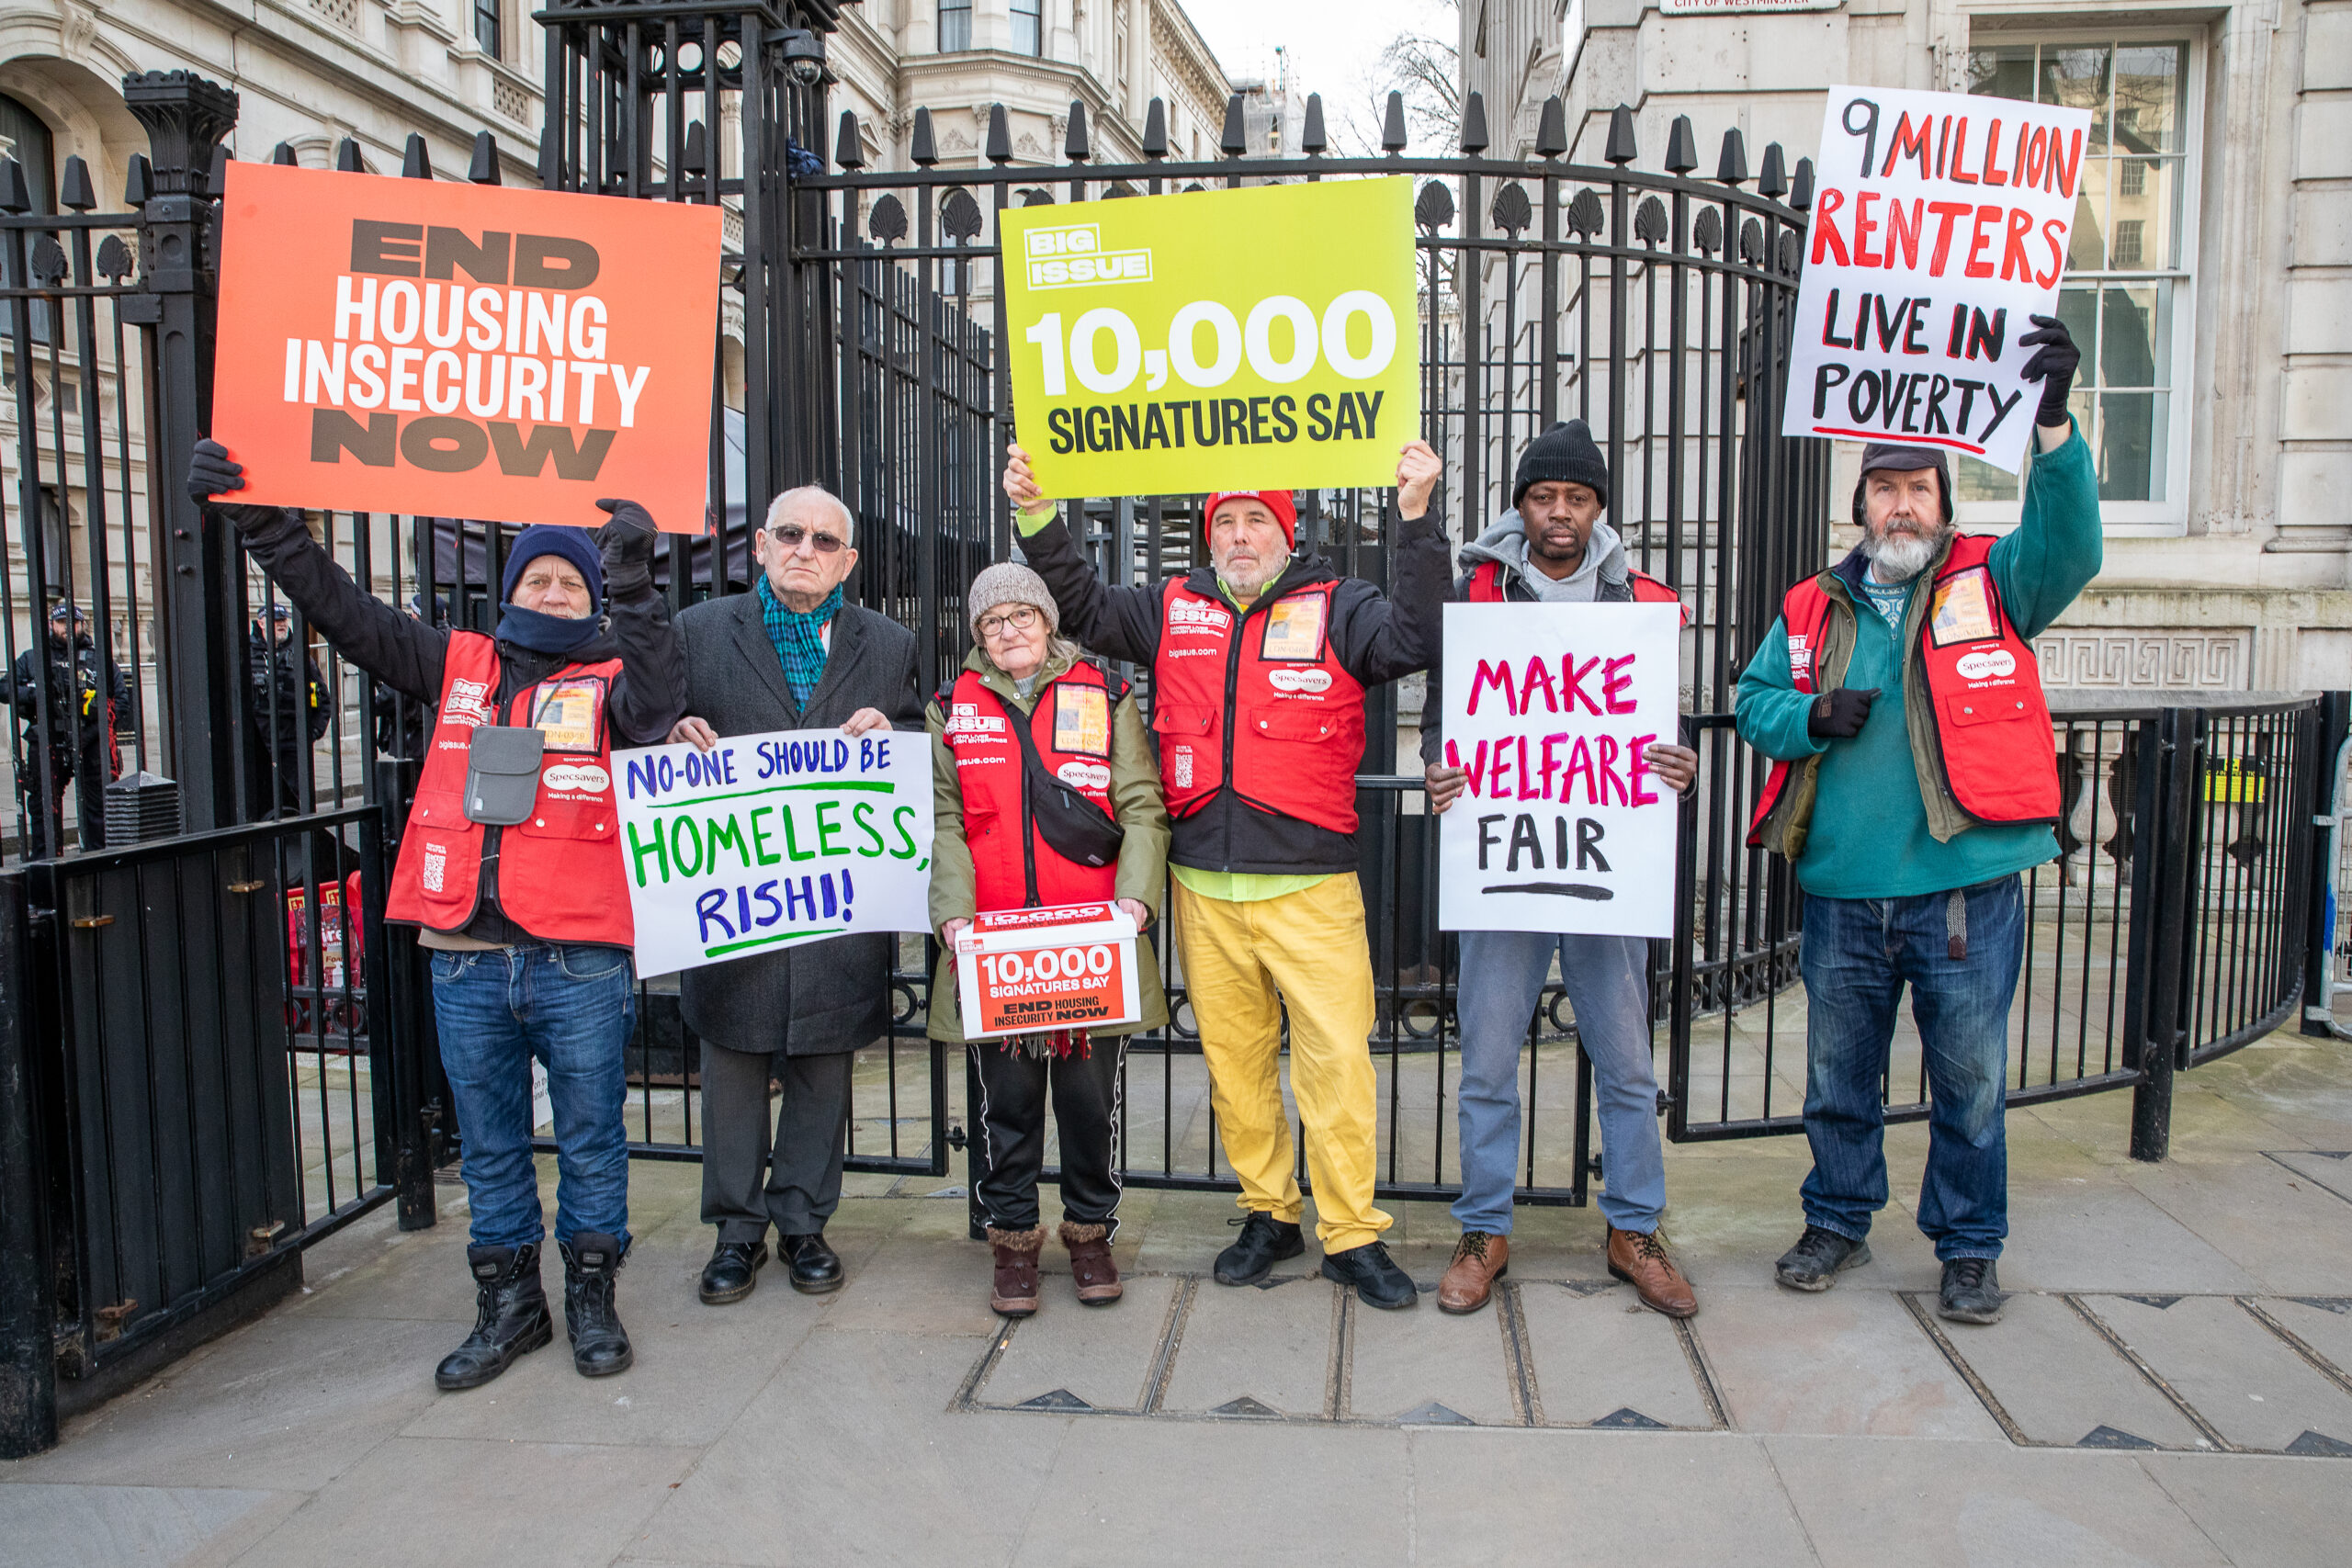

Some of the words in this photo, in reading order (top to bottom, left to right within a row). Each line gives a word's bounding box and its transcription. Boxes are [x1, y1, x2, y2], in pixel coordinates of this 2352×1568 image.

[1842, 98, 1880, 178] 9
[1882, 110, 2082, 198] MILLION
[350, 219, 600, 290] END
[1029, 230, 1096, 255] BIG
[1811, 187, 2067, 290] RENTERS
[1032, 254, 1148, 285] ISSUE
[334, 276, 608, 361] HOUSING
[1025, 289, 1396, 396] 10,000
[1822, 288, 1931, 355] LIVE
[1947, 303, 2007, 363] IN
[283, 338, 650, 428] INSECURITY
[1812, 364, 2021, 444] POVERTY
[310, 408, 616, 481] NOW
[1047, 395, 1298, 455] SIGNATURES
[1306, 390, 1385, 441] SAY
[1170, 610, 1227, 626] ISSUE
[1275, 673, 1328, 684] Specsavers
[1466, 652, 1638, 716] MAKE
[1962, 660, 2012, 671] Specsavers
[548, 792, 571, 801] Making
[549, 773, 605, 784] Specsavers
[628, 749, 738, 799] NO-ONE
[757, 739, 850, 779] SHOULD
[860, 739, 891, 773] BE
[1063, 770, 1108, 781] Specsavers
[1445, 732, 1659, 808] WELFARE
[628, 800, 930, 888] HOMELESS,
[1477, 813, 1613, 873] FAIR
[322, 928, 342, 943] ire
[695, 868, 854, 943] RISHI!
[981, 945, 1113, 986] 10,000
[989, 978, 1080, 998] SIGNATURES
[1082, 976, 1110, 989] SAY
[994, 1011, 1053, 1027] INSECURITY
[1057, 1007, 1109, 1021] NOW
[1003, 1000, 1053, 1014] END
[1055, 996, 1099, 1010] HOUSING
